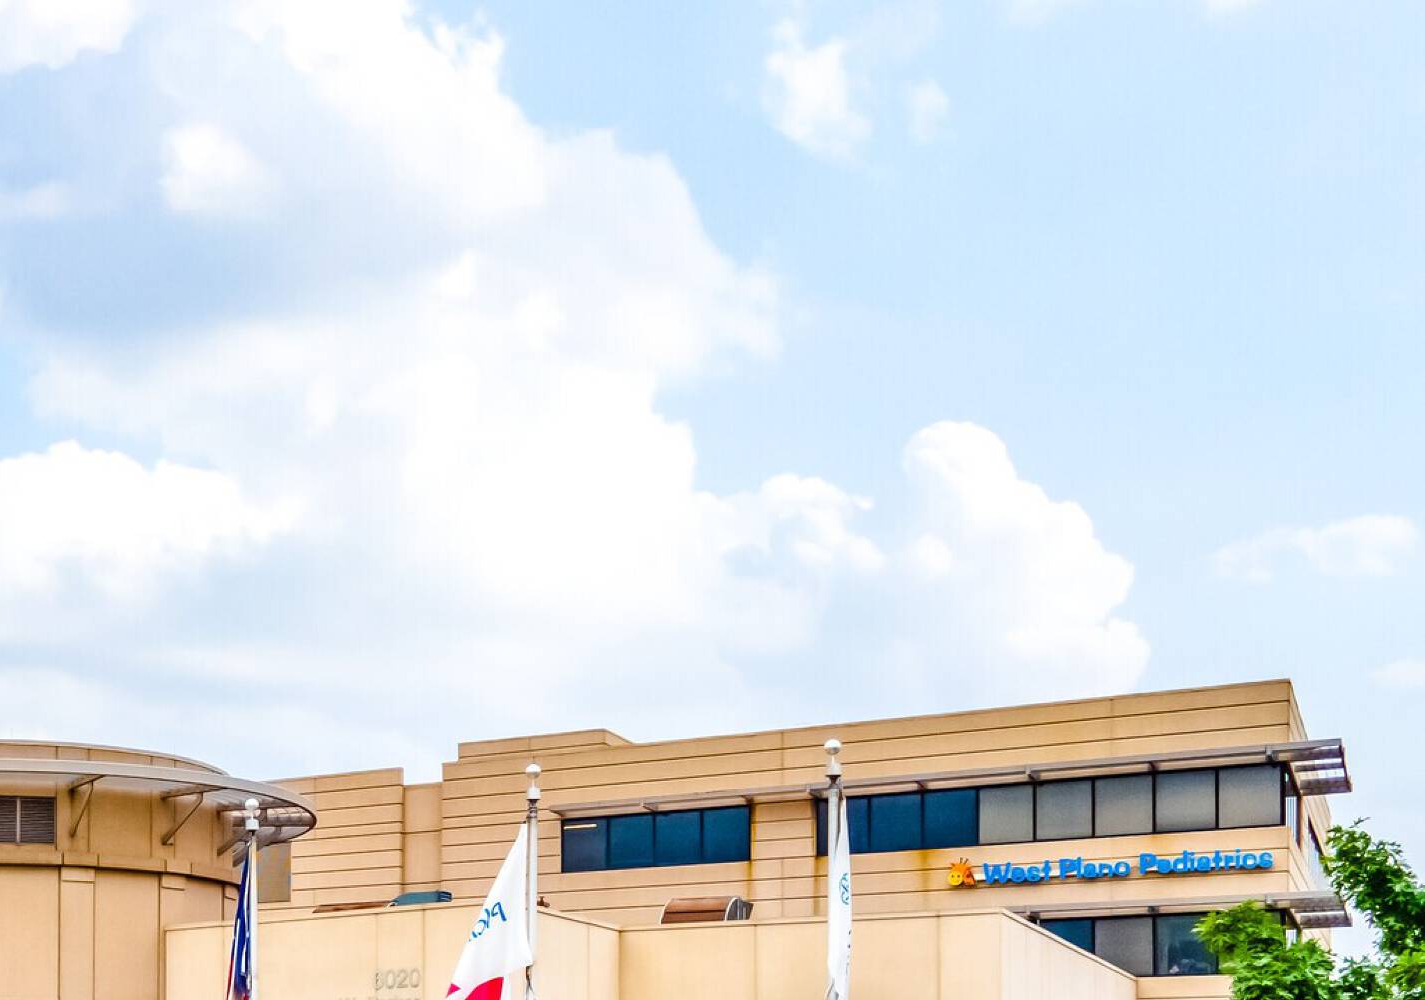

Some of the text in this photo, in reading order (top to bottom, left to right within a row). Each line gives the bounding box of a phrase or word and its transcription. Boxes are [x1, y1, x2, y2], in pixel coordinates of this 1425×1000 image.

[982, 848, 1273, 884] West Plano Pediatrics
[374, 968, 420, 991] 6020
